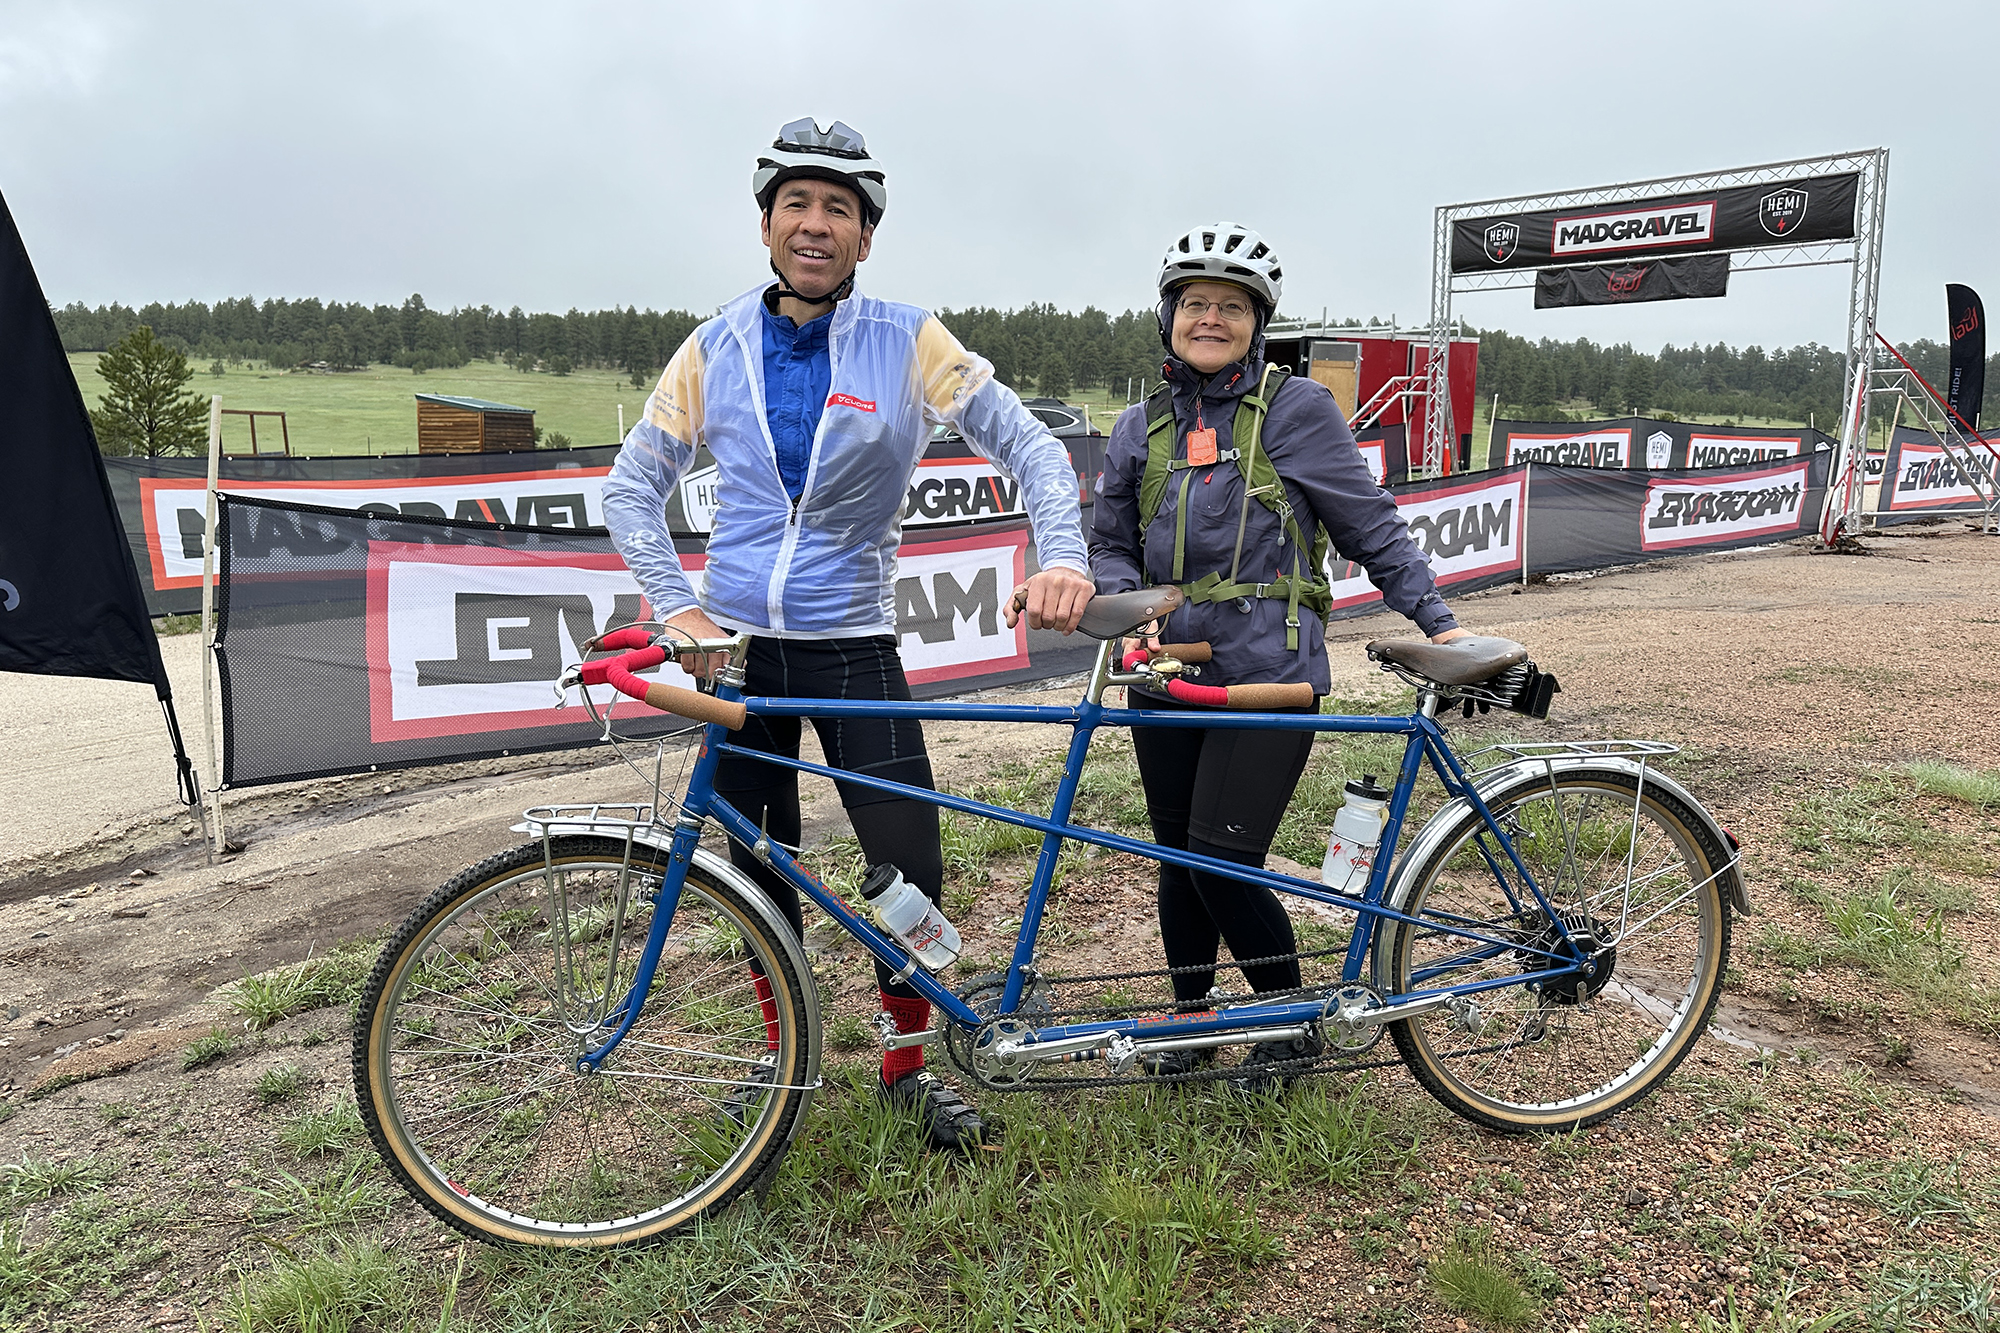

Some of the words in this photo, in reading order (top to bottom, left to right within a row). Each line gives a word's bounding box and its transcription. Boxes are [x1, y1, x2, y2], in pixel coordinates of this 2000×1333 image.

[1767, 195, 1800, 211] HEMI
[1490, 228, 1514, 242] HEMI
[1559, 212, 1705, 246] MADGRAVEL
[697, 484, 720, 506] HE
